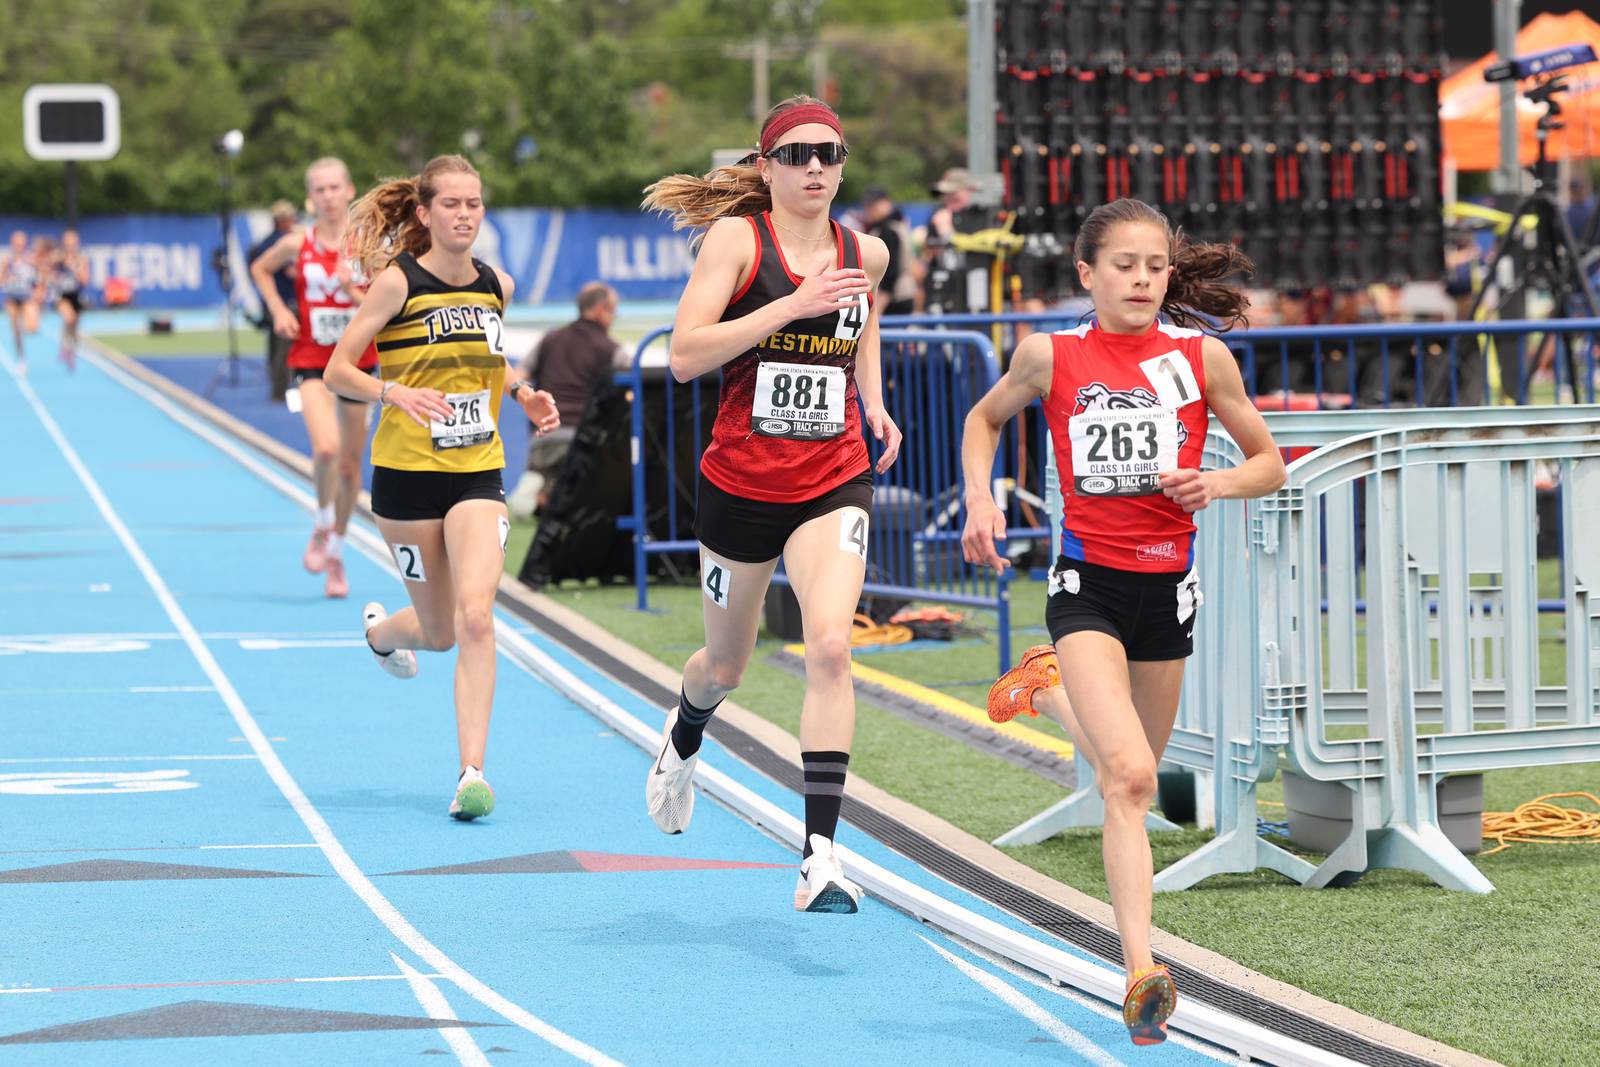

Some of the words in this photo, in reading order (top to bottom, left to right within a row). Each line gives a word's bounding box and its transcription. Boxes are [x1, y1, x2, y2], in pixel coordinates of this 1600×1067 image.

[84, 243, 201, 289] TERN
[598, 236, 698, 280] ILLIN
[423, 304, 487, 344] TUSCO
[489, 316, 503, 352] 2
[844, 293, 862, 338] 4
[771, 373, 829, 410] 881
[1158, 357, 1189, 401] 1
[771, 408, 796, 419] CLASS
[798, 411, 807, 420] 1A
[808, 411, 829, 421] GIRLS
[793, 421, 813, 432] TRACK
[820, 423, 837, 433] FIELD
[1086, 421, 1158, 462] 263
[1090, 464, 1118, 474] CLASS
[1121, 463, 1132, 473] 1A
[1134, 462, 1159, 473] GIRLS
[1116, 476, 1140, 488] TRACK
[847, 516, 865, 556] 4
[400, 546, 420, 579] 2
[706, 565, 723, 603] 4
